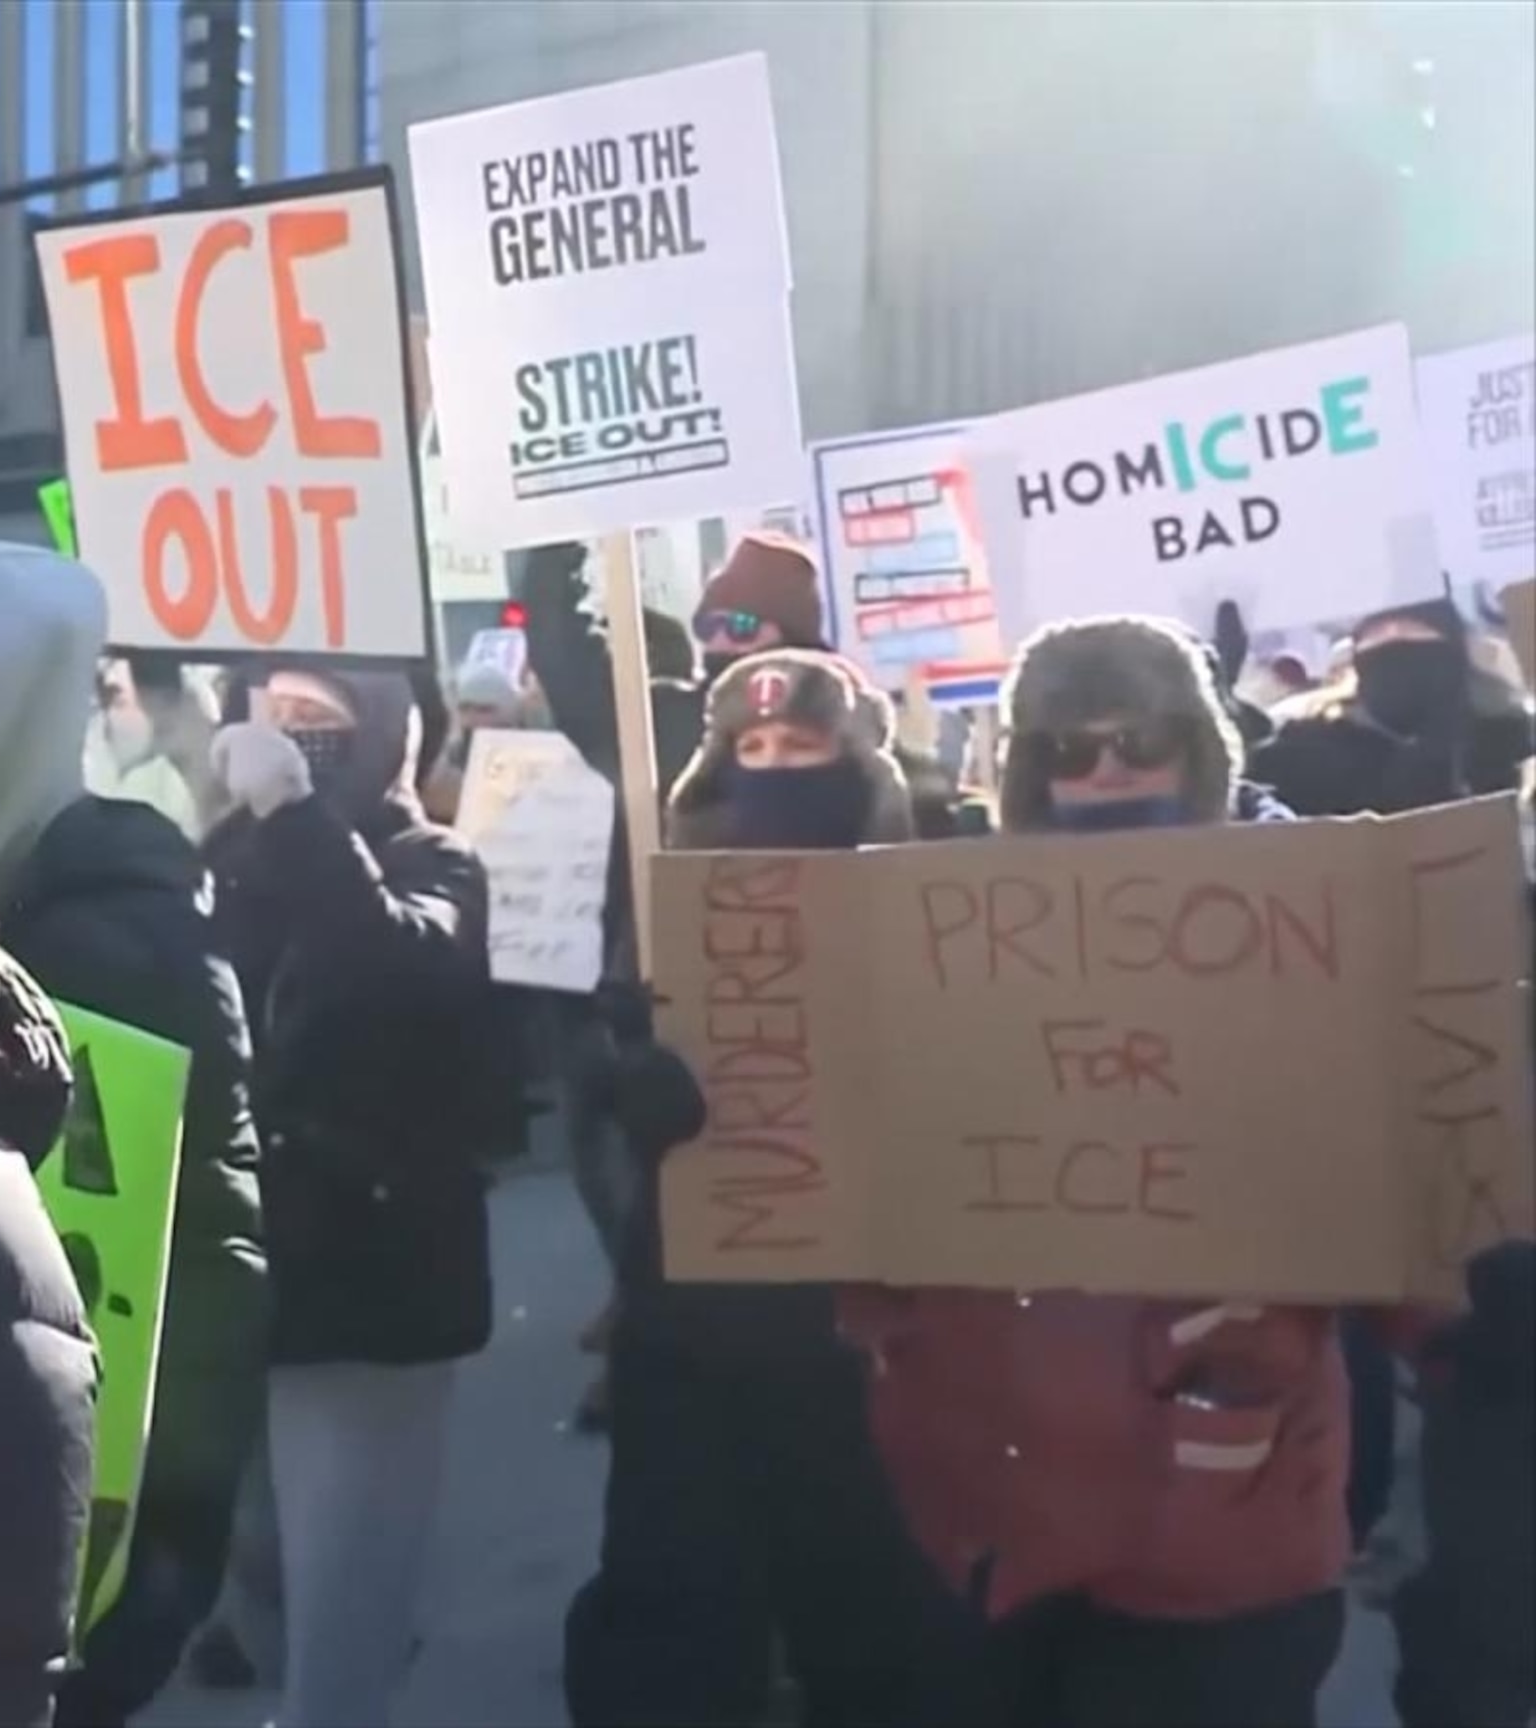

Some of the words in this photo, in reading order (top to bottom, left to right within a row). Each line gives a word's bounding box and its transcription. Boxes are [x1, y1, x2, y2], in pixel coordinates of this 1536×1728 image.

[483, 138, 621, 211] EXPAND
[628, 123, 699, 184] THE
[490, 184, 706, 285] GENERAL
[64, 209, 381, 472] ICE
[515, 334, 702, 432] STRIKE!
[511, 432, 586, 465] ICE
[597, 408, 722, 450] OUT!
[1017, 378, 1379, 520] HOMICIDE
[1467, 404, 1522, 450] FOR
[142, 485, 357, 648] OUT
[1153, 497, 1280, 563] BAD
[920, 876, 1339, 989] PRISON
[962, 1133, 1198, 1222] ICE
